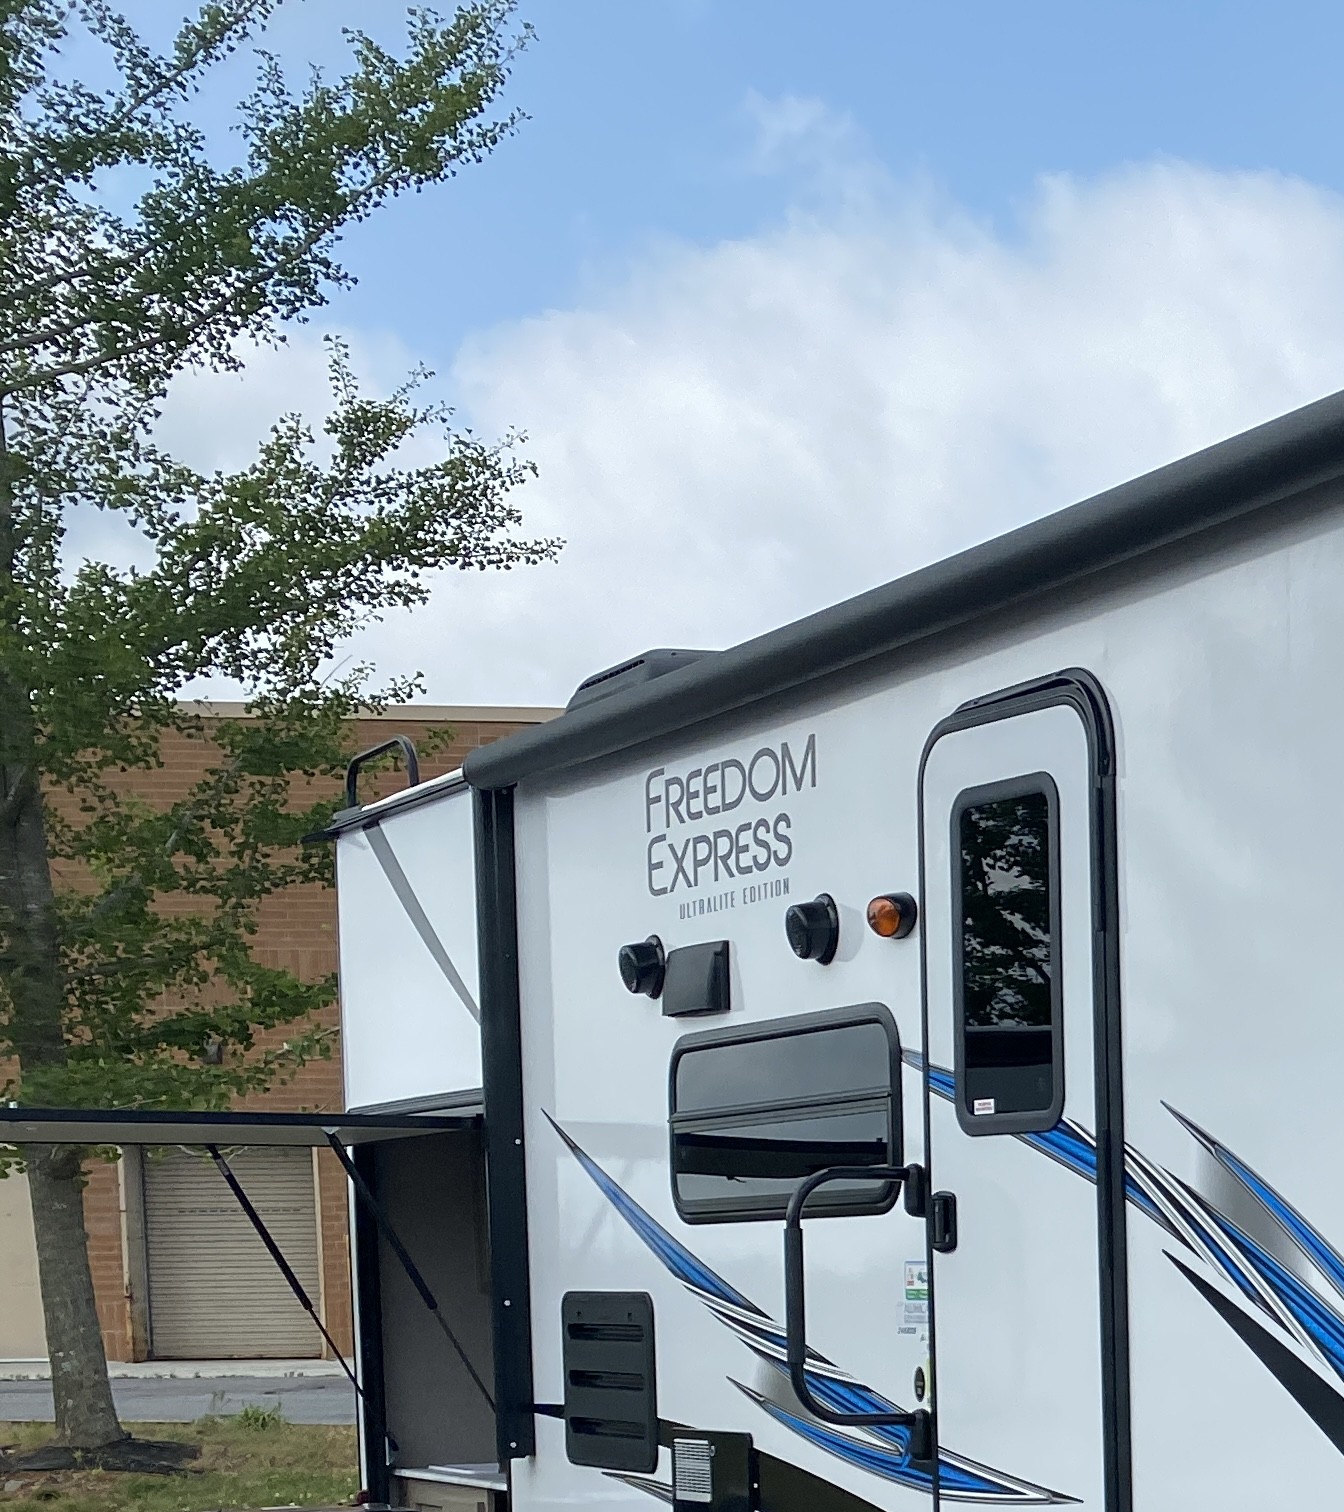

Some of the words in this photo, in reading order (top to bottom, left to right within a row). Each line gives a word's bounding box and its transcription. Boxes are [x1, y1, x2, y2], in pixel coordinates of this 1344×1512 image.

[645, 733, 817, 833] FREEDOM
[647, 812, 793, 897] EXPRESS
[678, 892, 736, 920] ULTRALITE
[742, 877, 790, 906] EDITION
